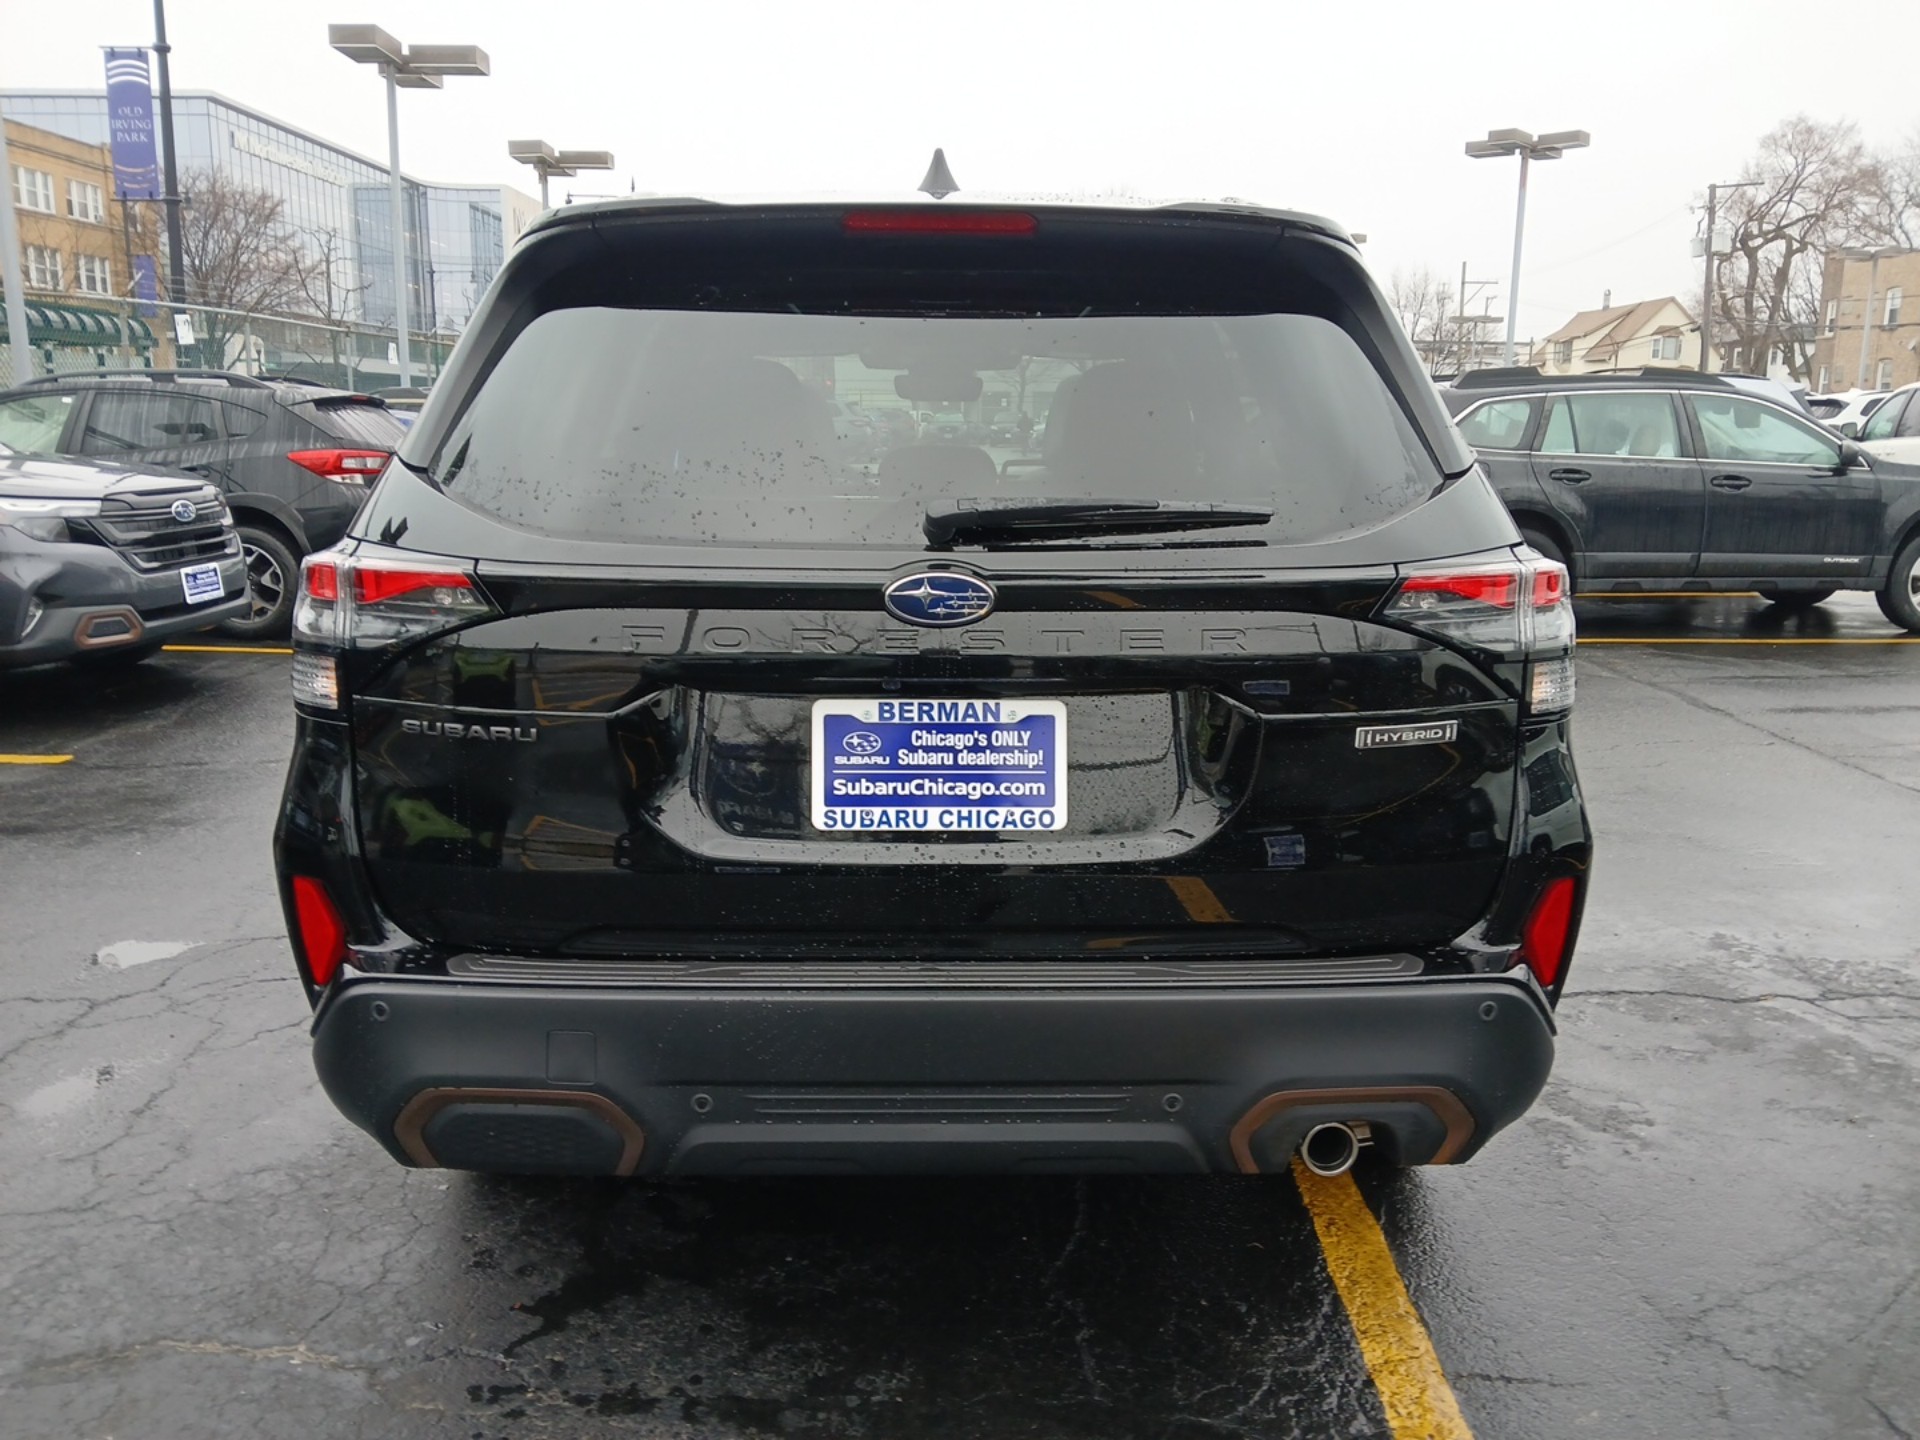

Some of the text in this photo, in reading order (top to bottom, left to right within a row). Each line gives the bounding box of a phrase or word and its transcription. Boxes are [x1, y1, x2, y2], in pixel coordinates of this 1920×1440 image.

[118, 106, 143, 117] OLD
[111, 119, 152, 130] IRVING
[116, 131, 149, 142] PARK
[621, 625, 1248, 655] FORESTER
[878, 702, 1001, 722] BERMAN
[401, 719, 537, 742] SUBARU
[911, 730, 1031, 749] Chicago's ONLY
[1375, 728, 1443, 743] HYBRID
[834, 756, 890, 764] SUBARU
[898, 750, 1043, 767] Subaru dealership!
[833, 778, 1046, 800] SubaruChicago.com
[823, 809, 1056, 829] SUBARU CHICAGO
